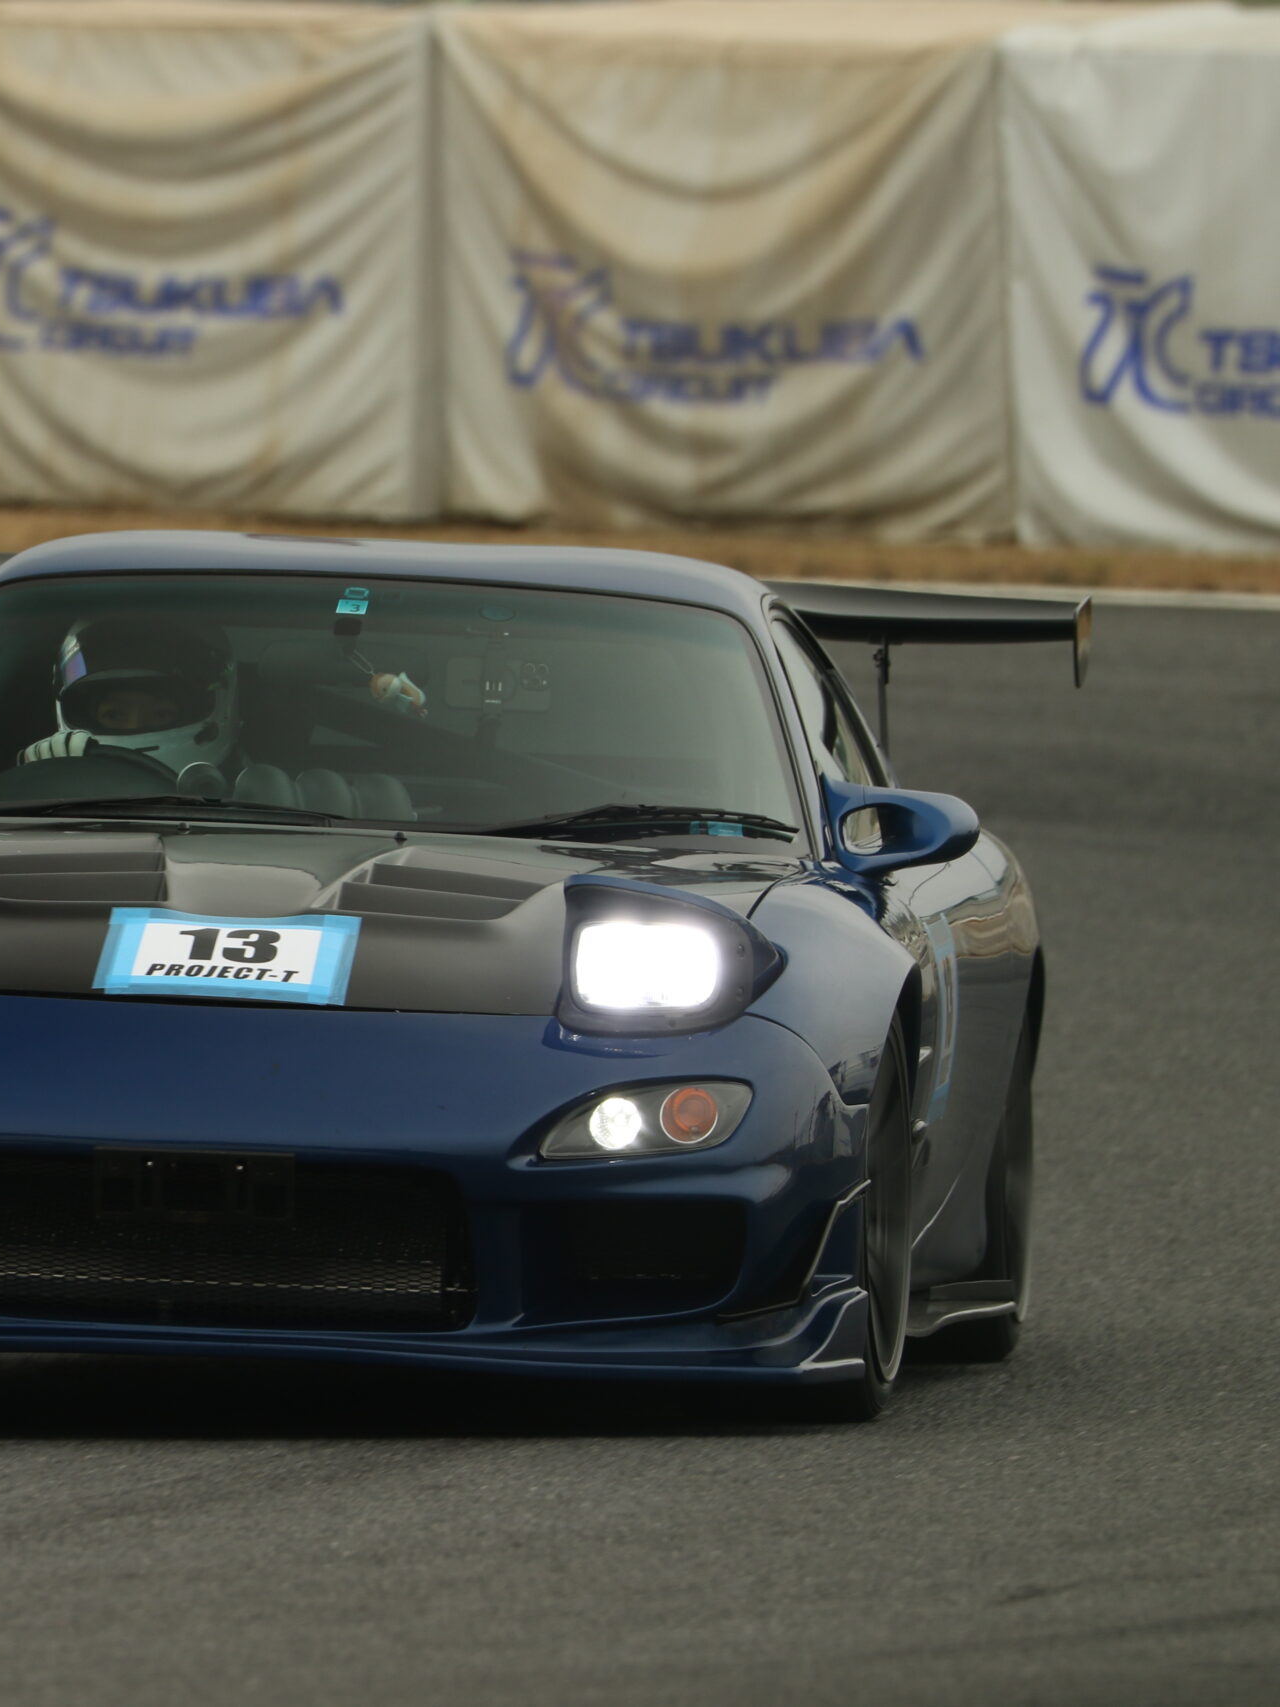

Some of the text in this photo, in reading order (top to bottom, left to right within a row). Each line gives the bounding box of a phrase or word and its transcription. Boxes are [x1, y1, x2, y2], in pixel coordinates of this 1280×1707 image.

[61, 268, 345, 318] TSUKUBA
[179, 928, 281, 964] 13
[145, 963, 300, 983] PROJECT-T
